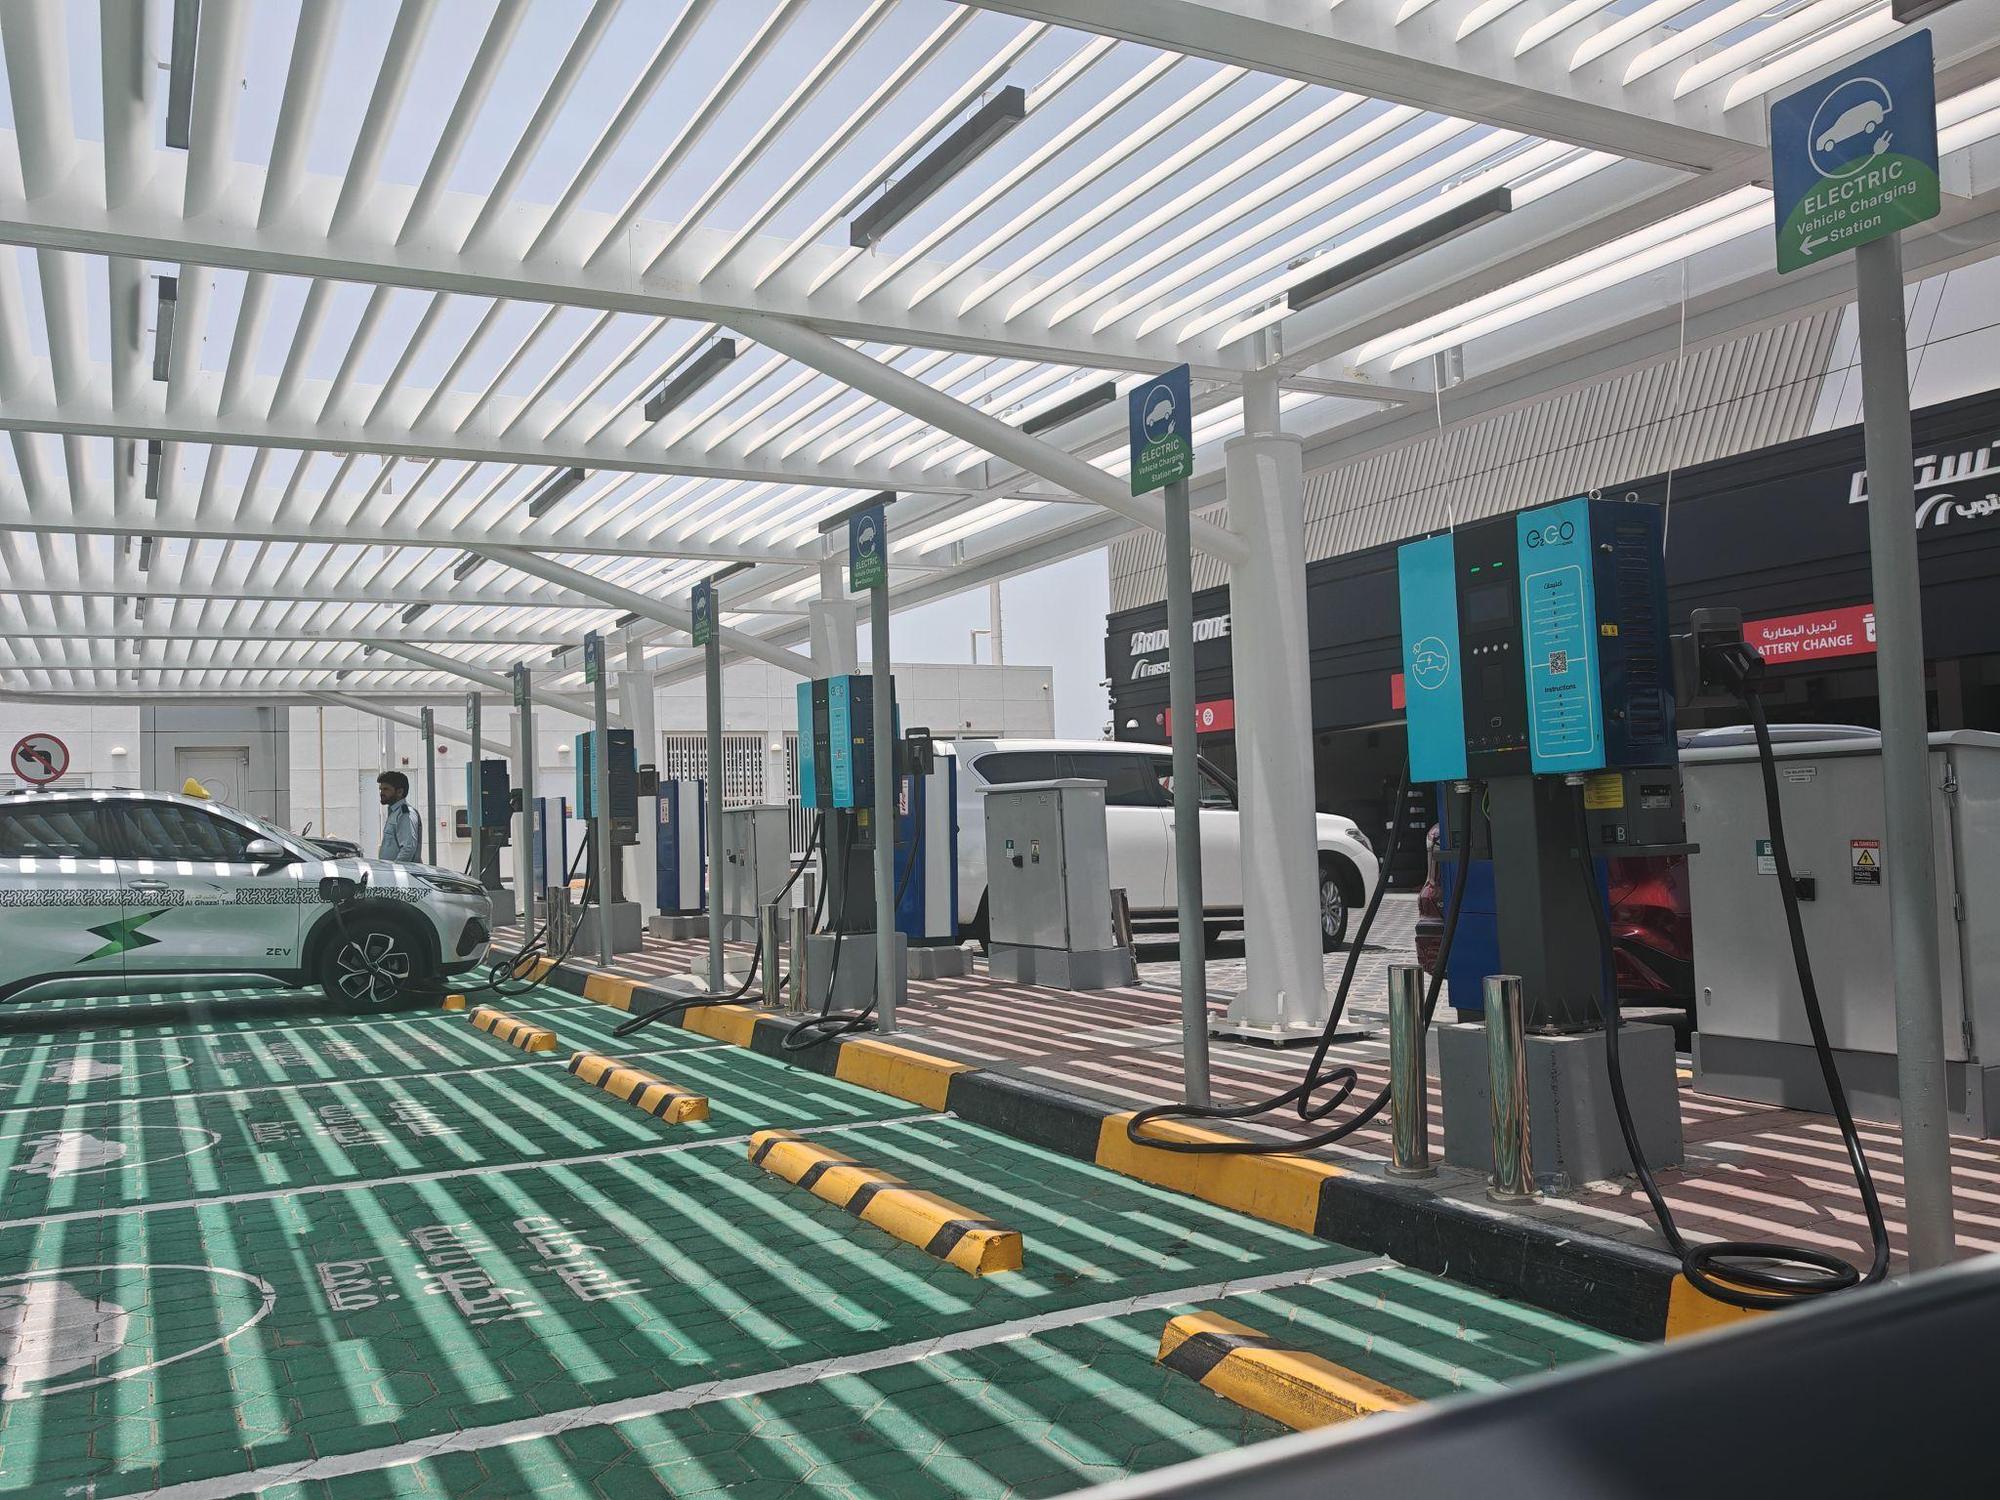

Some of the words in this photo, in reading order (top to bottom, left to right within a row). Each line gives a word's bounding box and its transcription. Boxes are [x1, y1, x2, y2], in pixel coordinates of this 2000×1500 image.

[1804, 160, 1905, 216] ELECTRIC
[1797, 207, 1846, 235] Vehicle
[1850, 180, 1917, 214] Charging
[1829, 213, 1882, 242] Station
[1141, 438, 1180, 463] ELECTRIC
[1158, 452, 1185, 468] Charging
[1762, 624, 1804, 641] البطارية
[1806, 619, 1838, 635] تبديل
[1757, 641, 1799, 656] ATTERY
[1802, 634, 1854, 651] CHANGE
[1617, 826, 1626, 841] B
[265, 947, 292, 956] ZEV
[314, 1256, 401, 1312] فقط
[400, 1220, 545, 1325] الكهربائية
